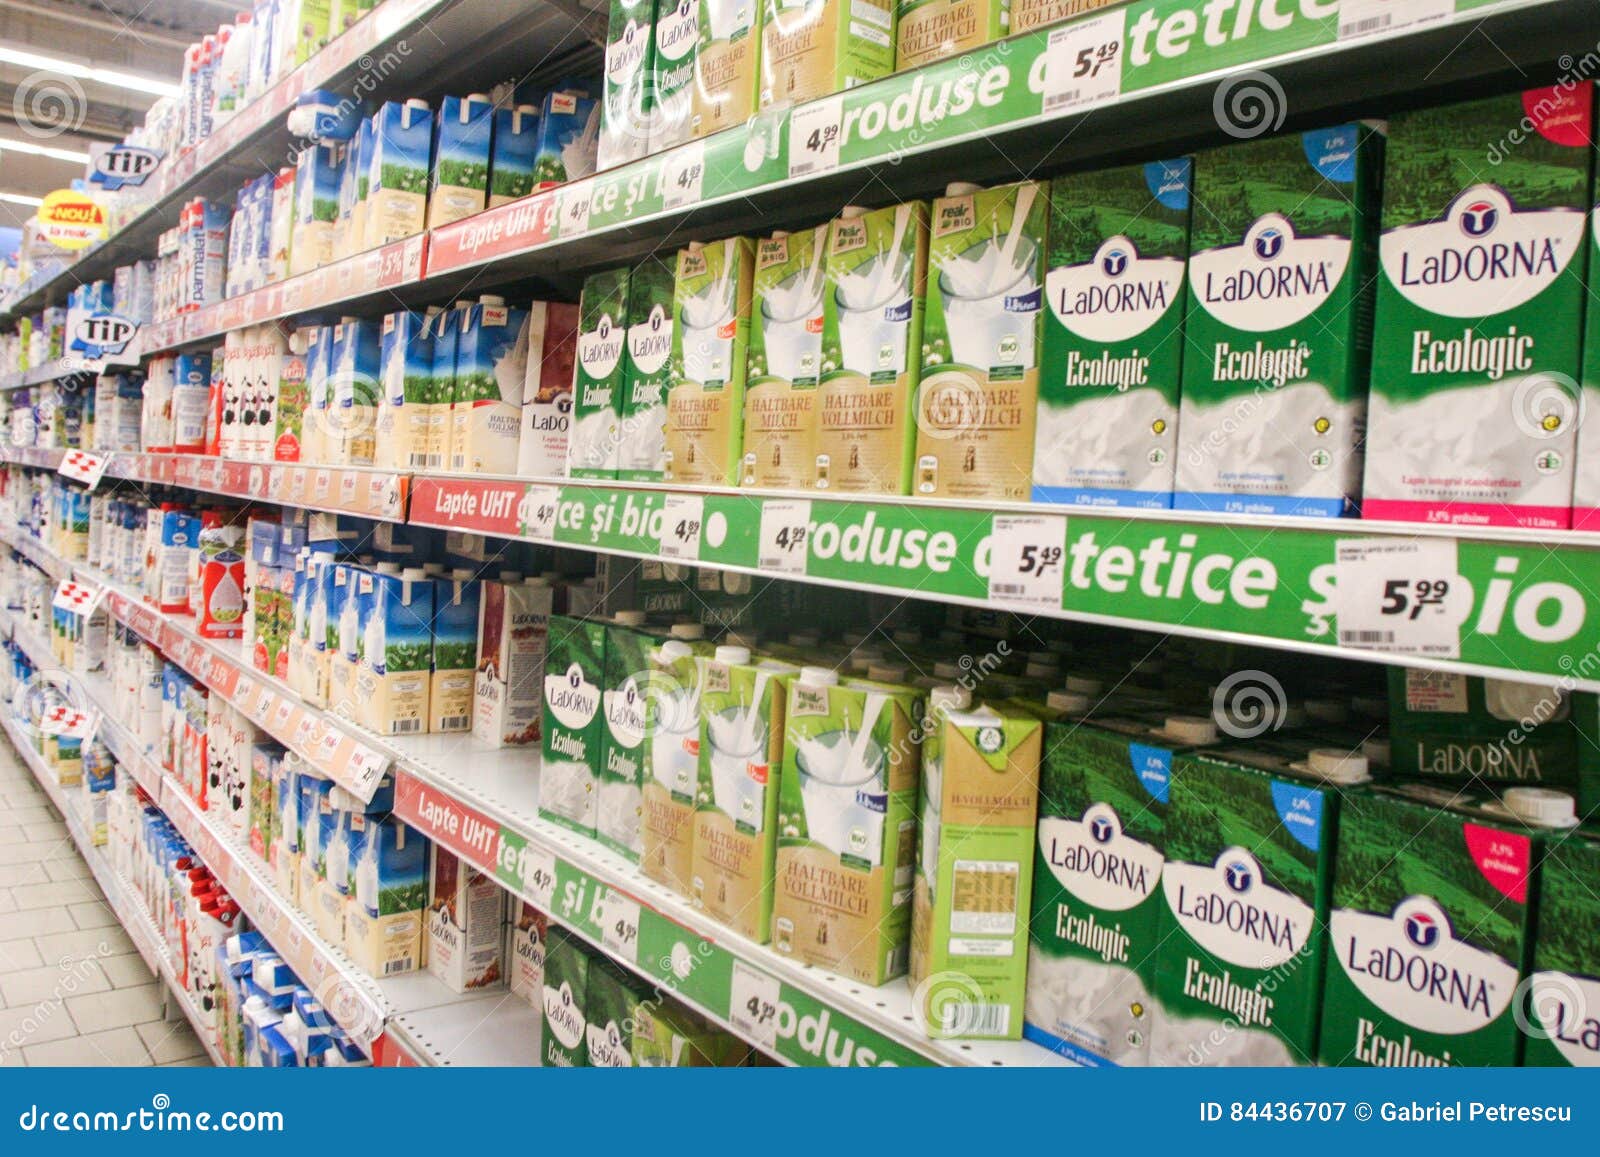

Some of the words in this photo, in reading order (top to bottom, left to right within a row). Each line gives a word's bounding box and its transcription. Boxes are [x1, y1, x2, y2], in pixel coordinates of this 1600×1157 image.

[905, 5, 974, 38] HALTBARE
[1073, 40, 1118, 78] 5,49
[840, 64, 1010, 147] roduse
[806, 124, 839, 154] 4,99
[105, 152, 153, 174] TiP
[456, 221, 500, 255] Lapte
[506, 200, 541, 238] UHT
[1401, 237, 1559, 286] LaDORNA
[1060, 280, 1168, 315] LaDORNA
[1206, 262, 1330, 303] LaDORNA
[84, 320, 130, 342] TiP
[1066, 349, 1149, 391] Ecologic
[1213, 339, 1311, 387] Ecologic
[1411, 326, 1535, 380] Ecologic
[821, 409, 894, 426] VOLLMILCH
[825, 392, 894, 409] HALTBARE
[761, 413, 798, 428] MILCH
[435, 487, 477, 520] Lapte
[481, 489, 517, 519] UHT
[589, 494, 617, 542] și
[675, 519, 700, 544] 4,89
[775, 527, 806, 553] 4,99
[1019, 545, 1062, 578] 5,49
[1381, 580, 1449, 621] 5,99
[1418, 742, 1541, 781] LaDORNA
[418, 791, 459, 836] Lapte
[463, 819, 496, 856] UHT
[787, 860, 866, 896] HALTBARE
[1050, 837, 1147, 896] LaDORNA
[783, 876, 869, 915] VOLLMILCH
[1055, 903, 1131, 963] Ecologic
[1178, 885, 1295, 952] LaDORNA
[1183, 957, 1274, 1028] Ecologic
[1349, 936, 1492, 1018] LaDORNA
